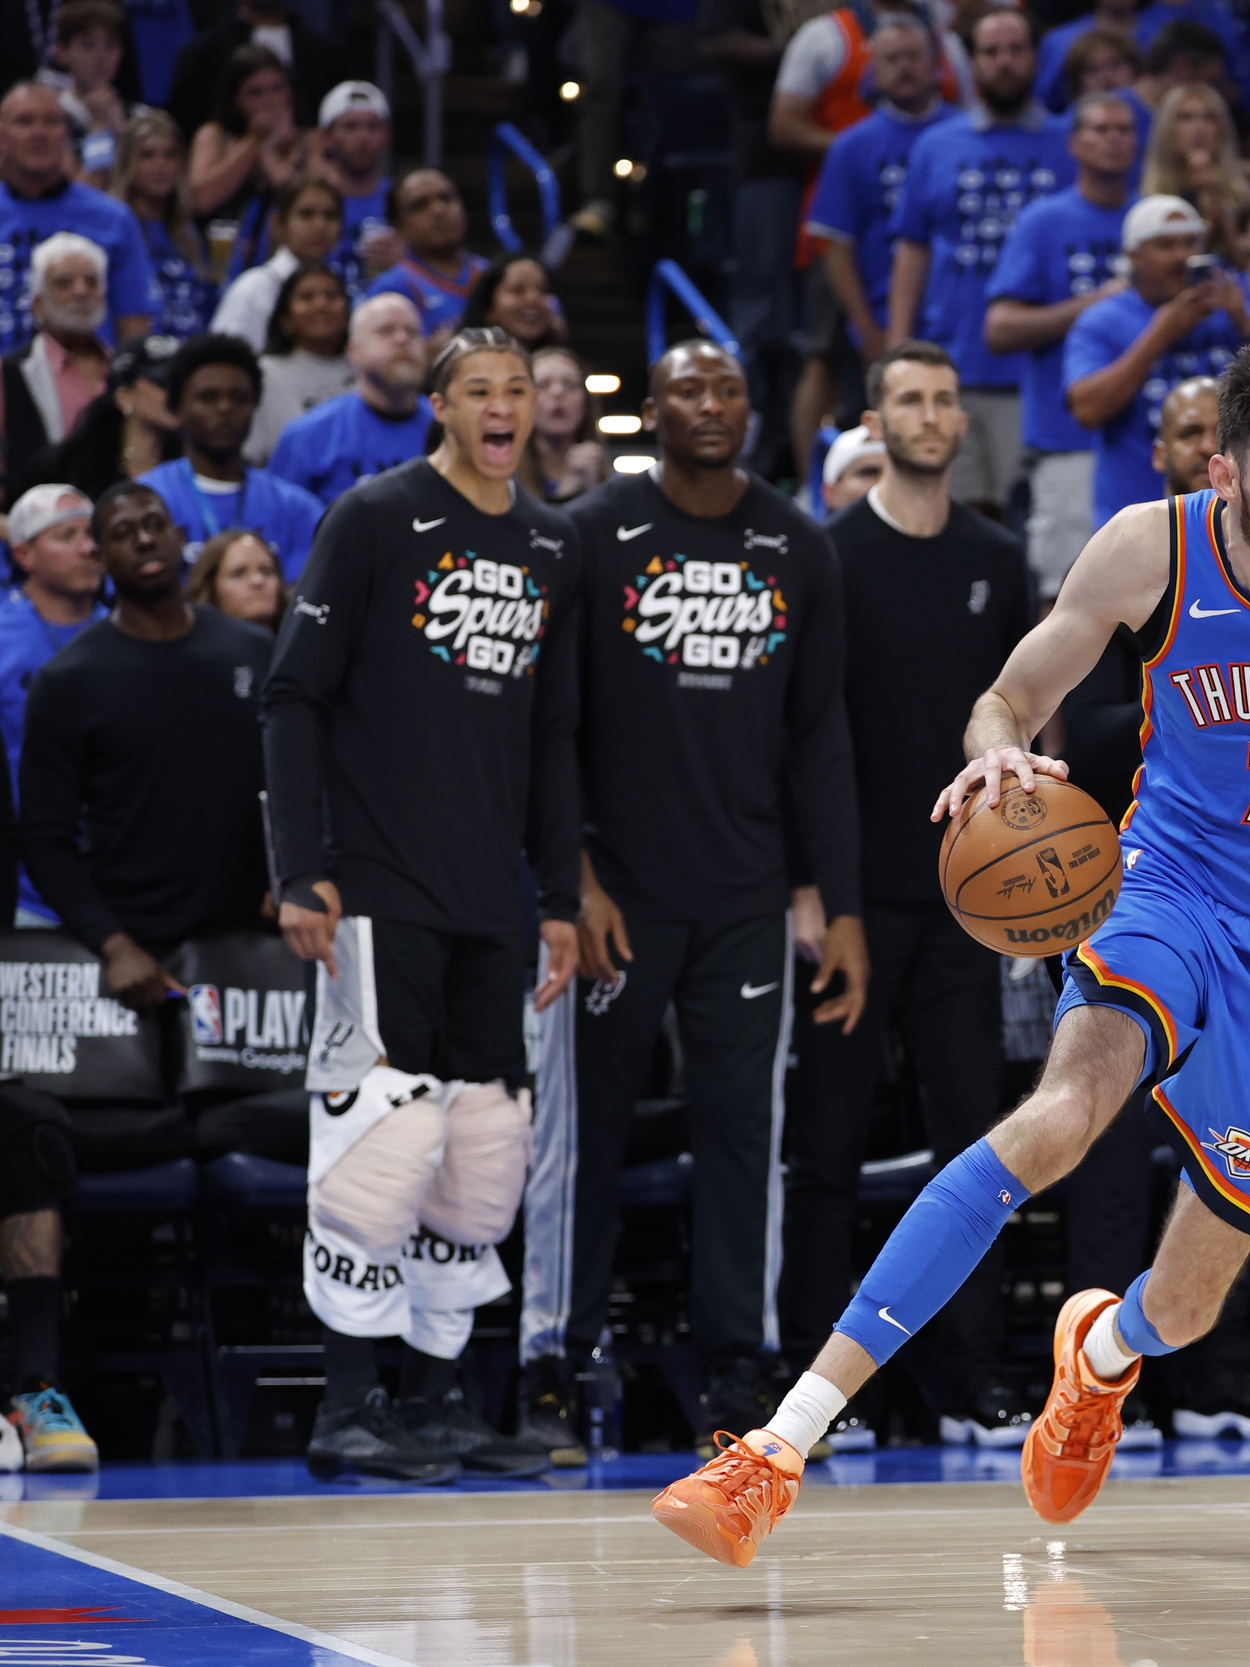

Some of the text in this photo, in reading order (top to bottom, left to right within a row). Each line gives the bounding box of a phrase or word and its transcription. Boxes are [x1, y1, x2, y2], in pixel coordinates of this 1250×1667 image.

[473, 559, 523, 599] GO
[683, 560, 742, 595] GO
[424, 569, 544, 650] Spurs
[634, 571, 773, 650] Spurs
[466, 635, 515, 675] GO
[682, 633, 740, 669] GO
[1004, 888, 1116, 944] Wilson
[0, 961, 99, 998] WESTERN
[1, 997, 138, 1036] CONFERENCE
[224, 986, 310, 1049] PLAY
[2, 1034, 77, 1074] FINALS
